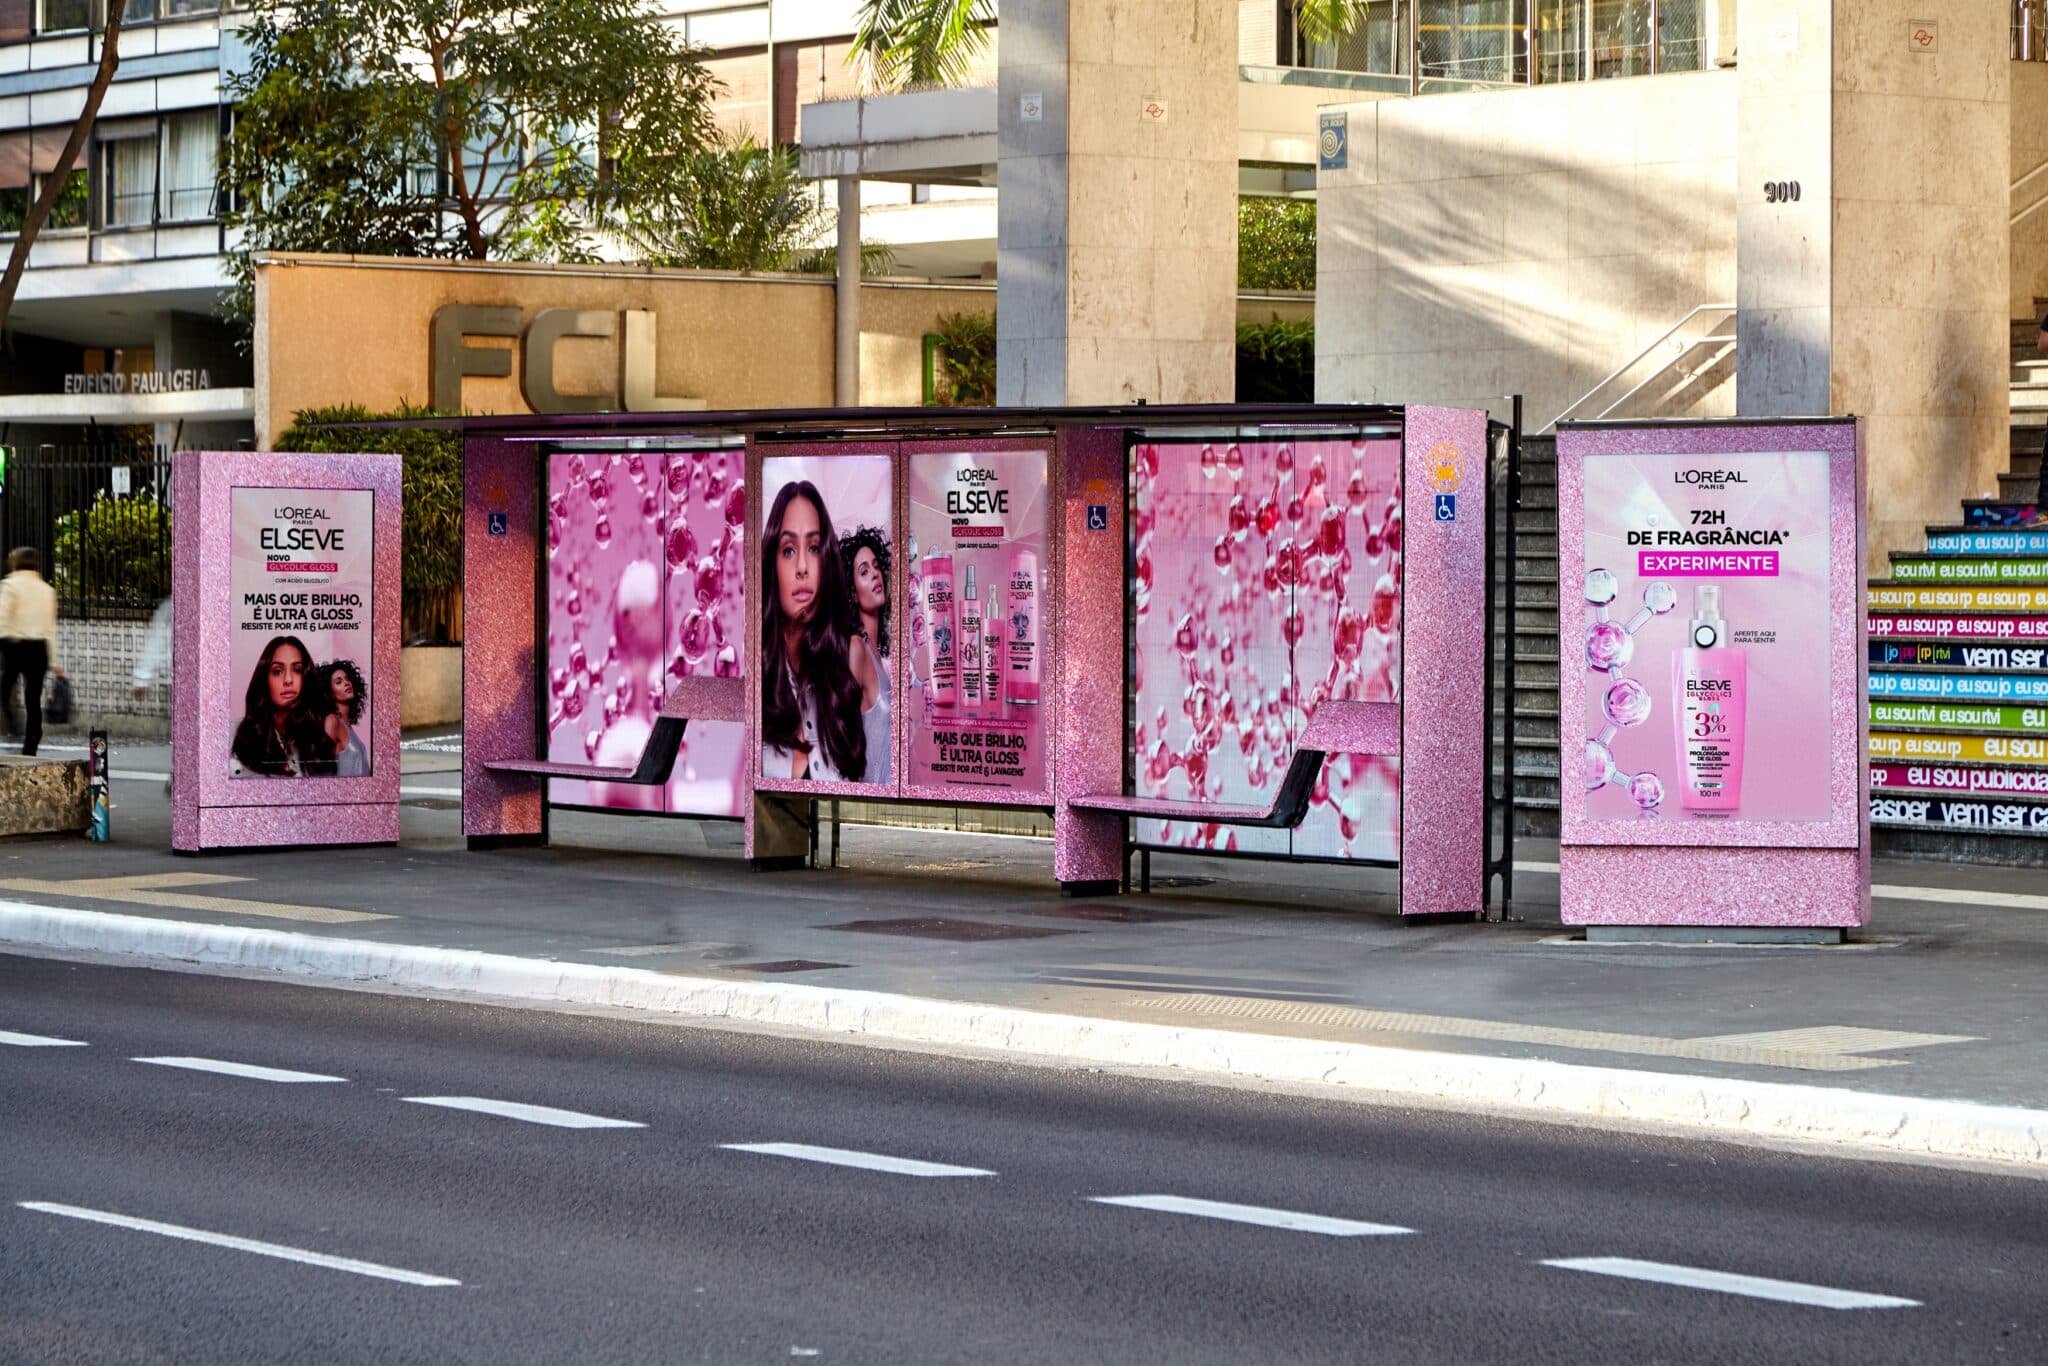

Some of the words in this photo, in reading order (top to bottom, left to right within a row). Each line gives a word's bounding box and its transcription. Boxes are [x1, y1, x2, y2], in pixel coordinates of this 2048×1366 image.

[1763, 180, 1801, 203] 900
[428, 303, 707, 413] FCL
[131, 369, 210, 393] PAULICEIA
[956, 468, 998, 482] L'ORÉAL
[1675, 469, 1748, 484] L'ORÉAL
[946, 490, 1009, 514] ELSEVE
[274, 506, 331, 520] L'ORÉAL
[1690, 510, 1725, 525] 72H
[260, 528, 344, 550] ELSEVE
[1627, 531, 1652, 545] DE
[269, 563, 307, 571] GLYCOLIC
[309, 563, 336, 572] GLOSS
[1643, 556, 1775, 571] EXPERIMENTE
[1010, 581, 1033, 590] ELSEVE
[244, 594, 277, 606] MAIS
[280, 594, 308, 606] QUE
[311, 594, 363, 608] BRILHO,
[928, 592, 953, 604] ELSEVE
[253, 606, 263, 620] É
[265, 609, 308, 620] ULTRA
[311, 609, 354, 620] GLOSS
[241, 623, 273, 631] RESISTE
[275, 623, 291, 631] POR
[293, 621, 308, 631] ATÉ
[309, 623, 316, 632] 6
[1962, 648, 2007, 669] vem
[2010, 648, 2044, 669] ser
[1686, 680, 1732, 691] ELSEVE
[1694, 712, 1726, 736] 3%
[2022, 708, 2046, 727] eu
[934, 731, 958, 745] MAIS
[961, 733, 983, 747] QUE
[985, 734, 1027, 751] BRILHO,
[1984, 738, 2007, 757] eu
[2010, 739, 2044, 758] sou
[940, 745, 947, 761] É
[950, 749, 983, 763] ULTRA
[985, 751, 1020, 765] GLOSS
[931, 763, 956, 773] RESISTE
[957, 764, 970, 774] POR
[971, 763, 983, 775] ATÉ
[984, 767, 989, 777] 6
[1907, 766, 1930, 786] eu
[1932, 767, 1967, 788] sou
[1940, 801, 1988, 827] vem
[1991, 804, 2028, 828] ser
